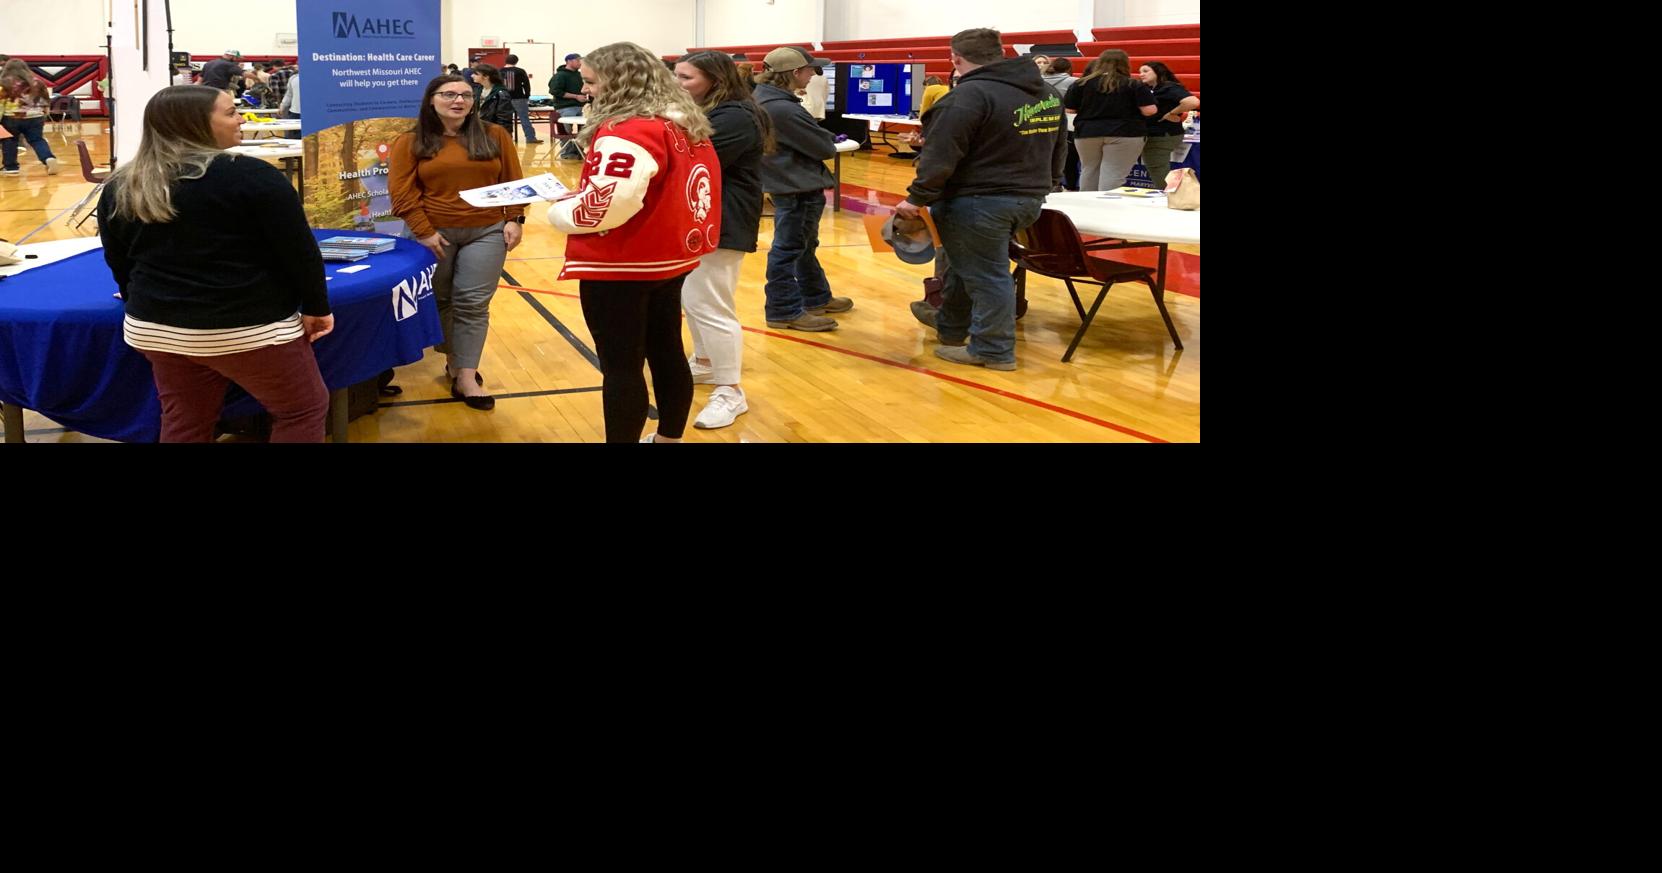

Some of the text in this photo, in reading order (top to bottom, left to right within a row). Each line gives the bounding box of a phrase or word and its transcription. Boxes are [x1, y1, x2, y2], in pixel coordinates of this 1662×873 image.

[312, 53, 435, 62] Destination: Health Care Career
[332, 69, 371, 77] Northwest
[372, 68, 403, 76] Missouri
[339, 80, 353, 88] will
[354, 79, 371, 89] help
[387, 80, 399, 88] get
[339, 167, 389, 180] Health Pro
[348, 192, 366, 200] AHEC
